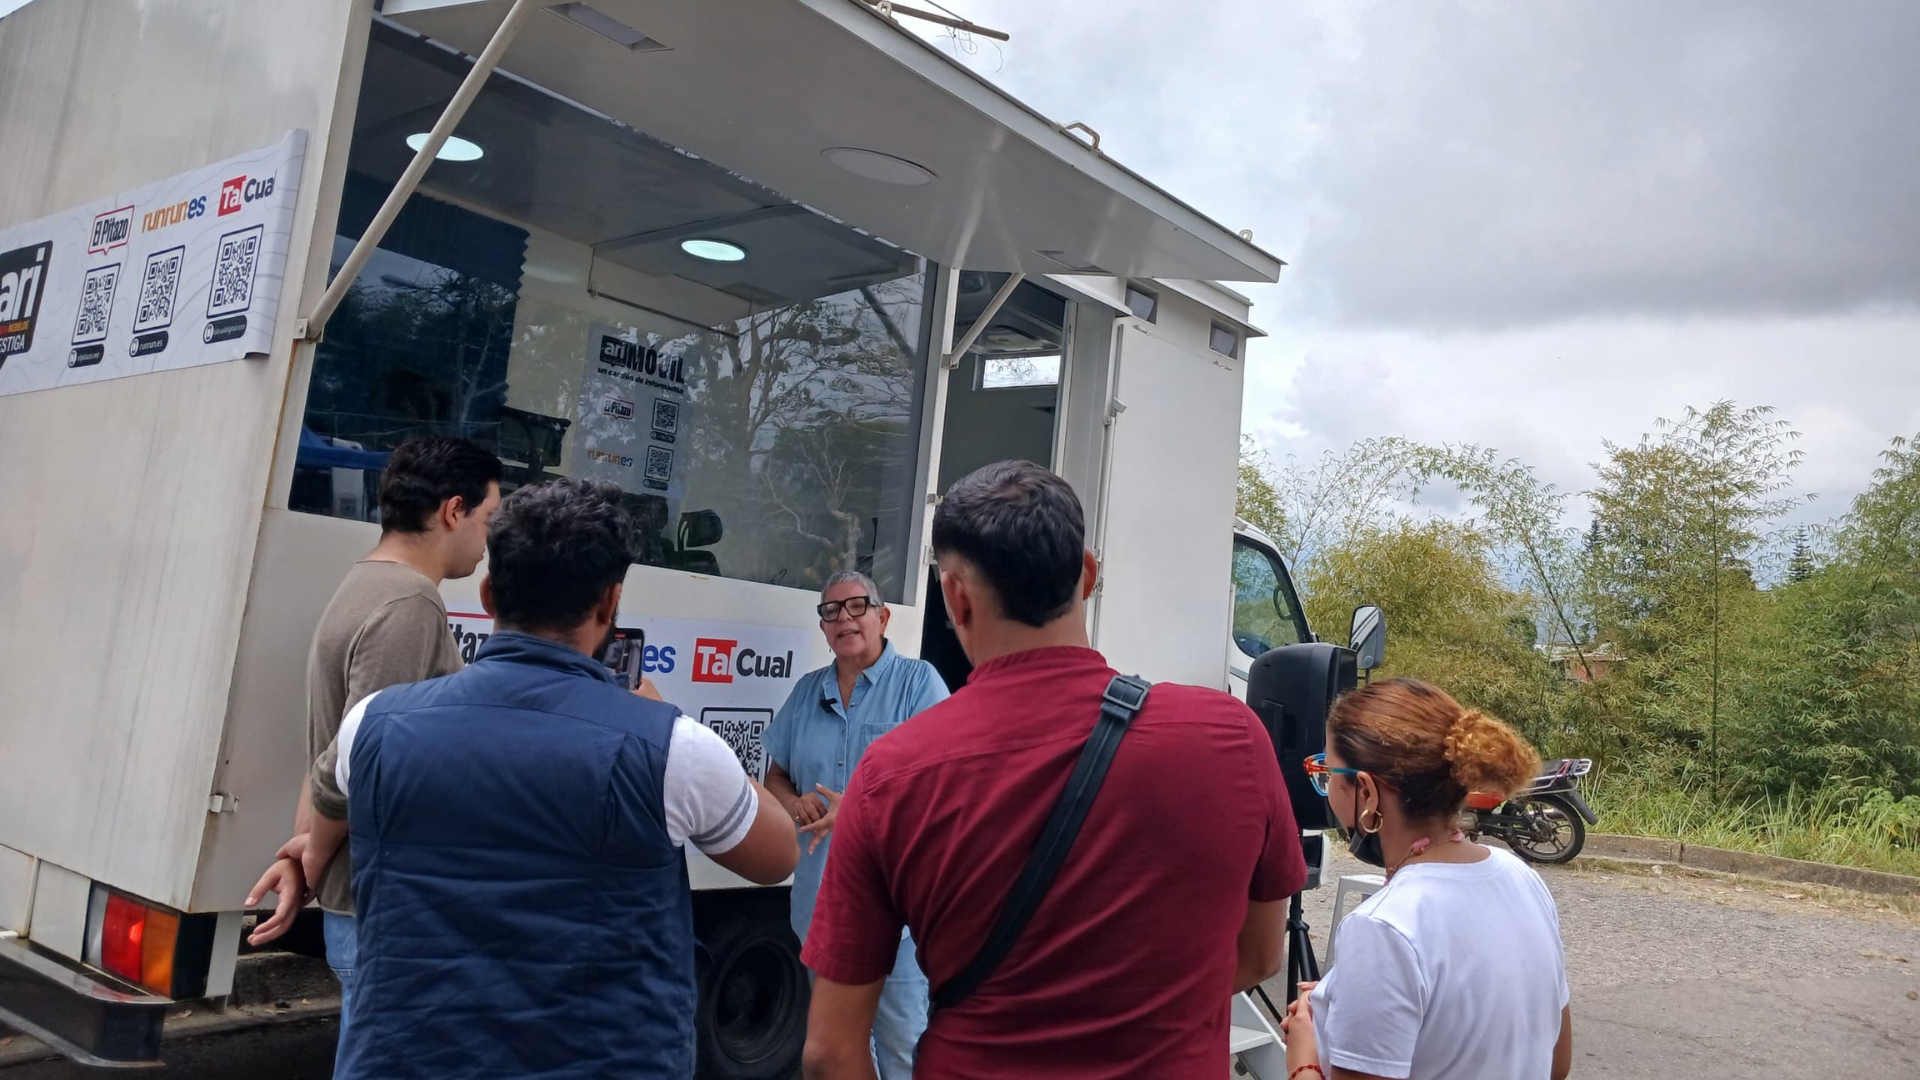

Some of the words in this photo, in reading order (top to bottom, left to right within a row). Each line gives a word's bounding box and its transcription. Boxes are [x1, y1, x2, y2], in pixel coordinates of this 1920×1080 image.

[244, 176, 276, 203] Cua
[141, 195, 207, 233] runrunes
[92, 220, 102, 247] El
[100, 217, 129, 244] Pitazo
[0, 247, 46, 321] ari
[603, 340, 626, 360] ari
[597, 366, 607, 375] un
[635, 374, 644, 384] de
[736, 648, 793, 678] Cual
